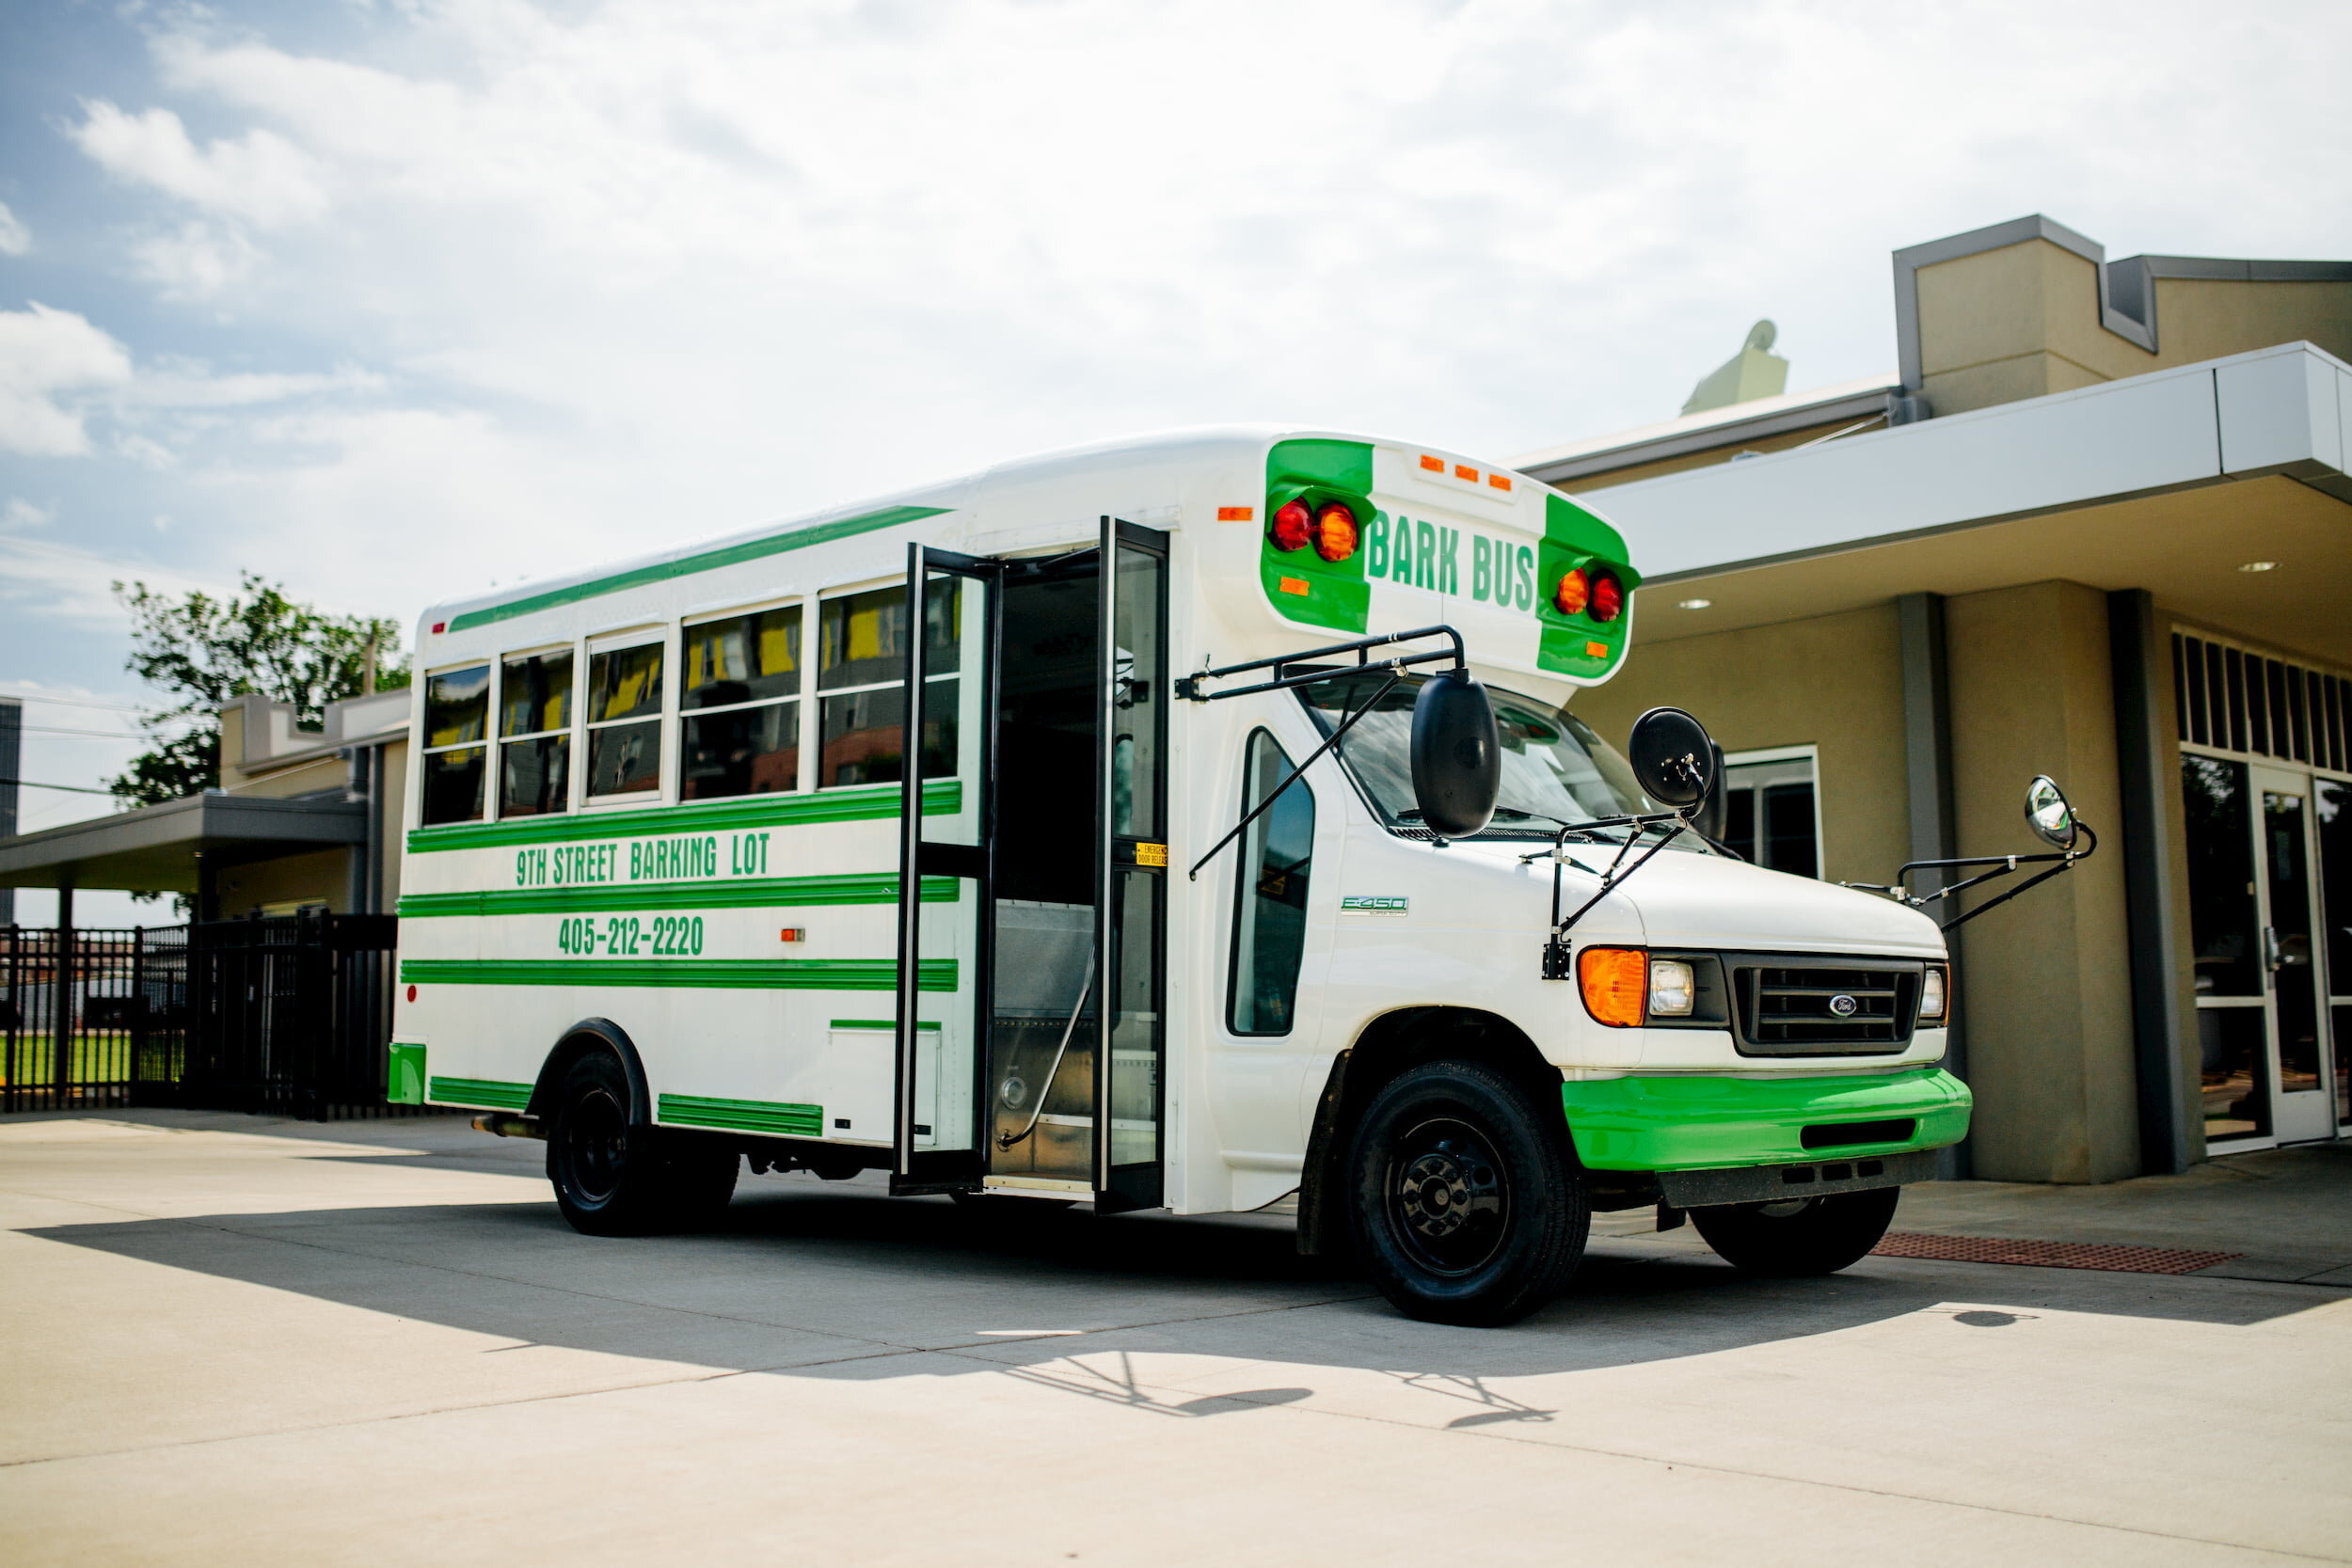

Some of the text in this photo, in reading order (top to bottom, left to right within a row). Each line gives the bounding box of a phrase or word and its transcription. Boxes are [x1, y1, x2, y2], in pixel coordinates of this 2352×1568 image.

[1368, 509, 1534, 611] BARK BUS
[516, 832, 771, 886] 9TH STREET BARKING LOT
[1145, 845, 1168, 854] EMERGENC
[1152, 855, 1168, 864] RELEAS
[559, 916, 704, 956] 405-212-2220
